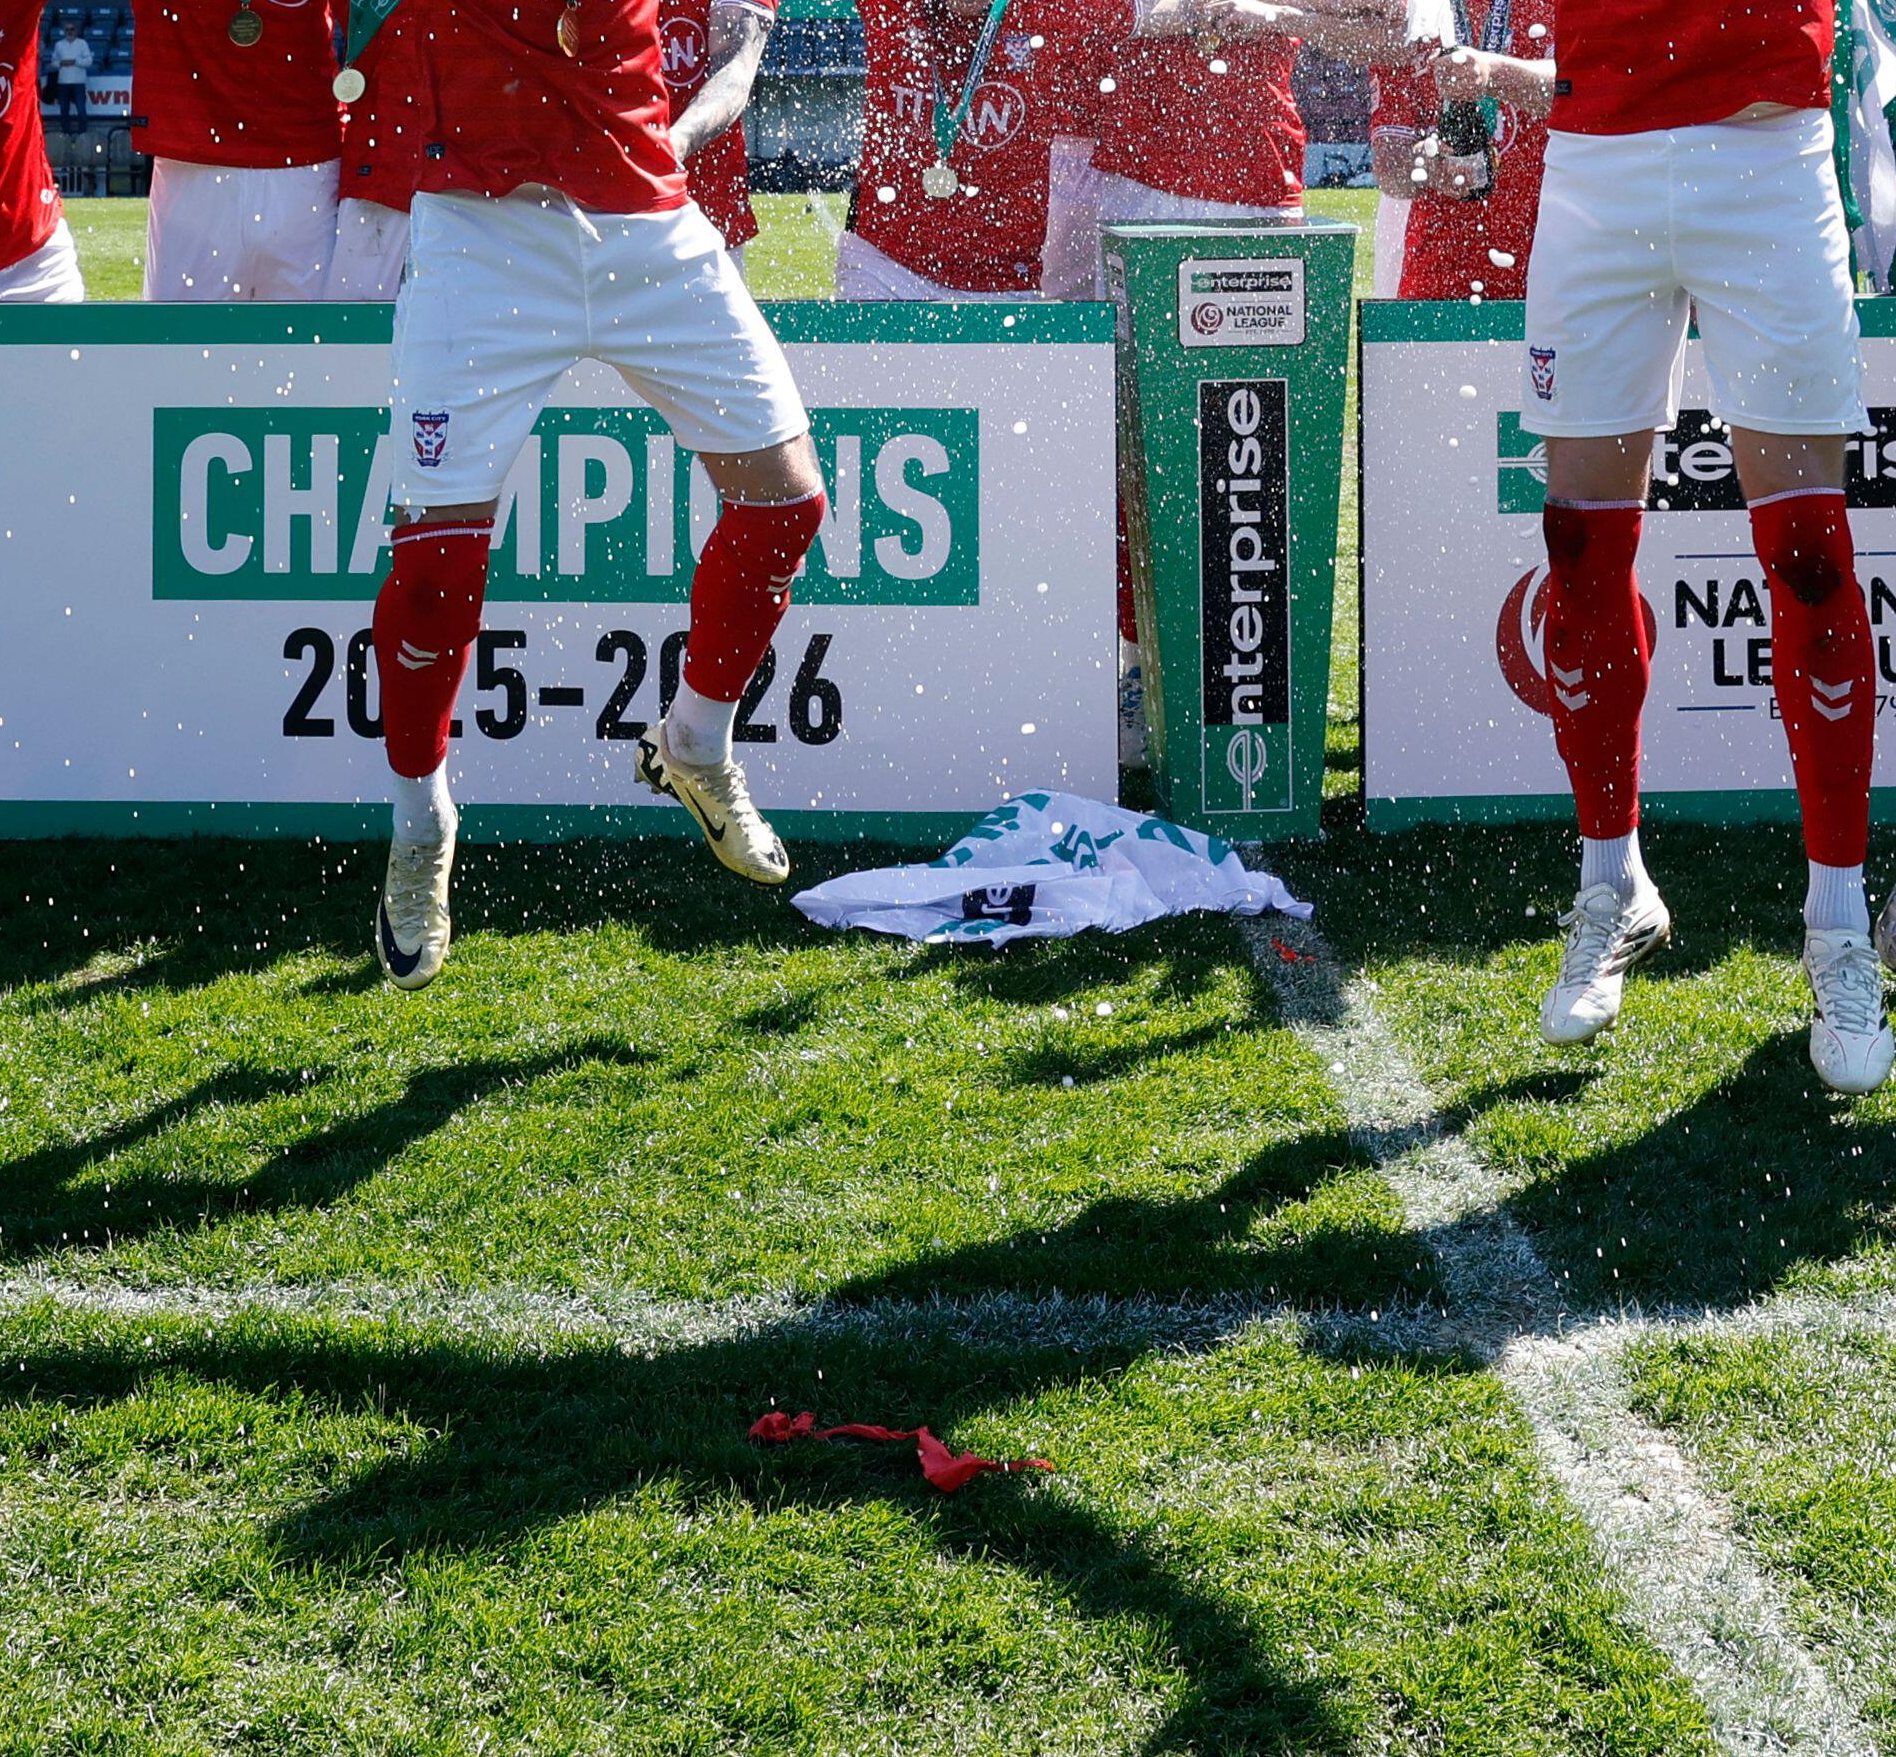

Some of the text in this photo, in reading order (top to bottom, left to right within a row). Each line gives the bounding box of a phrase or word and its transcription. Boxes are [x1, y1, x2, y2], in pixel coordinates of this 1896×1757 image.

[1191, 274, 1293, 291] enterprise
[1226, 305, 1293, 317] NATIONAL
[1234, 316, 1286, 329] LEAGUE
[1216, 388, 1277, 808] enterprise
